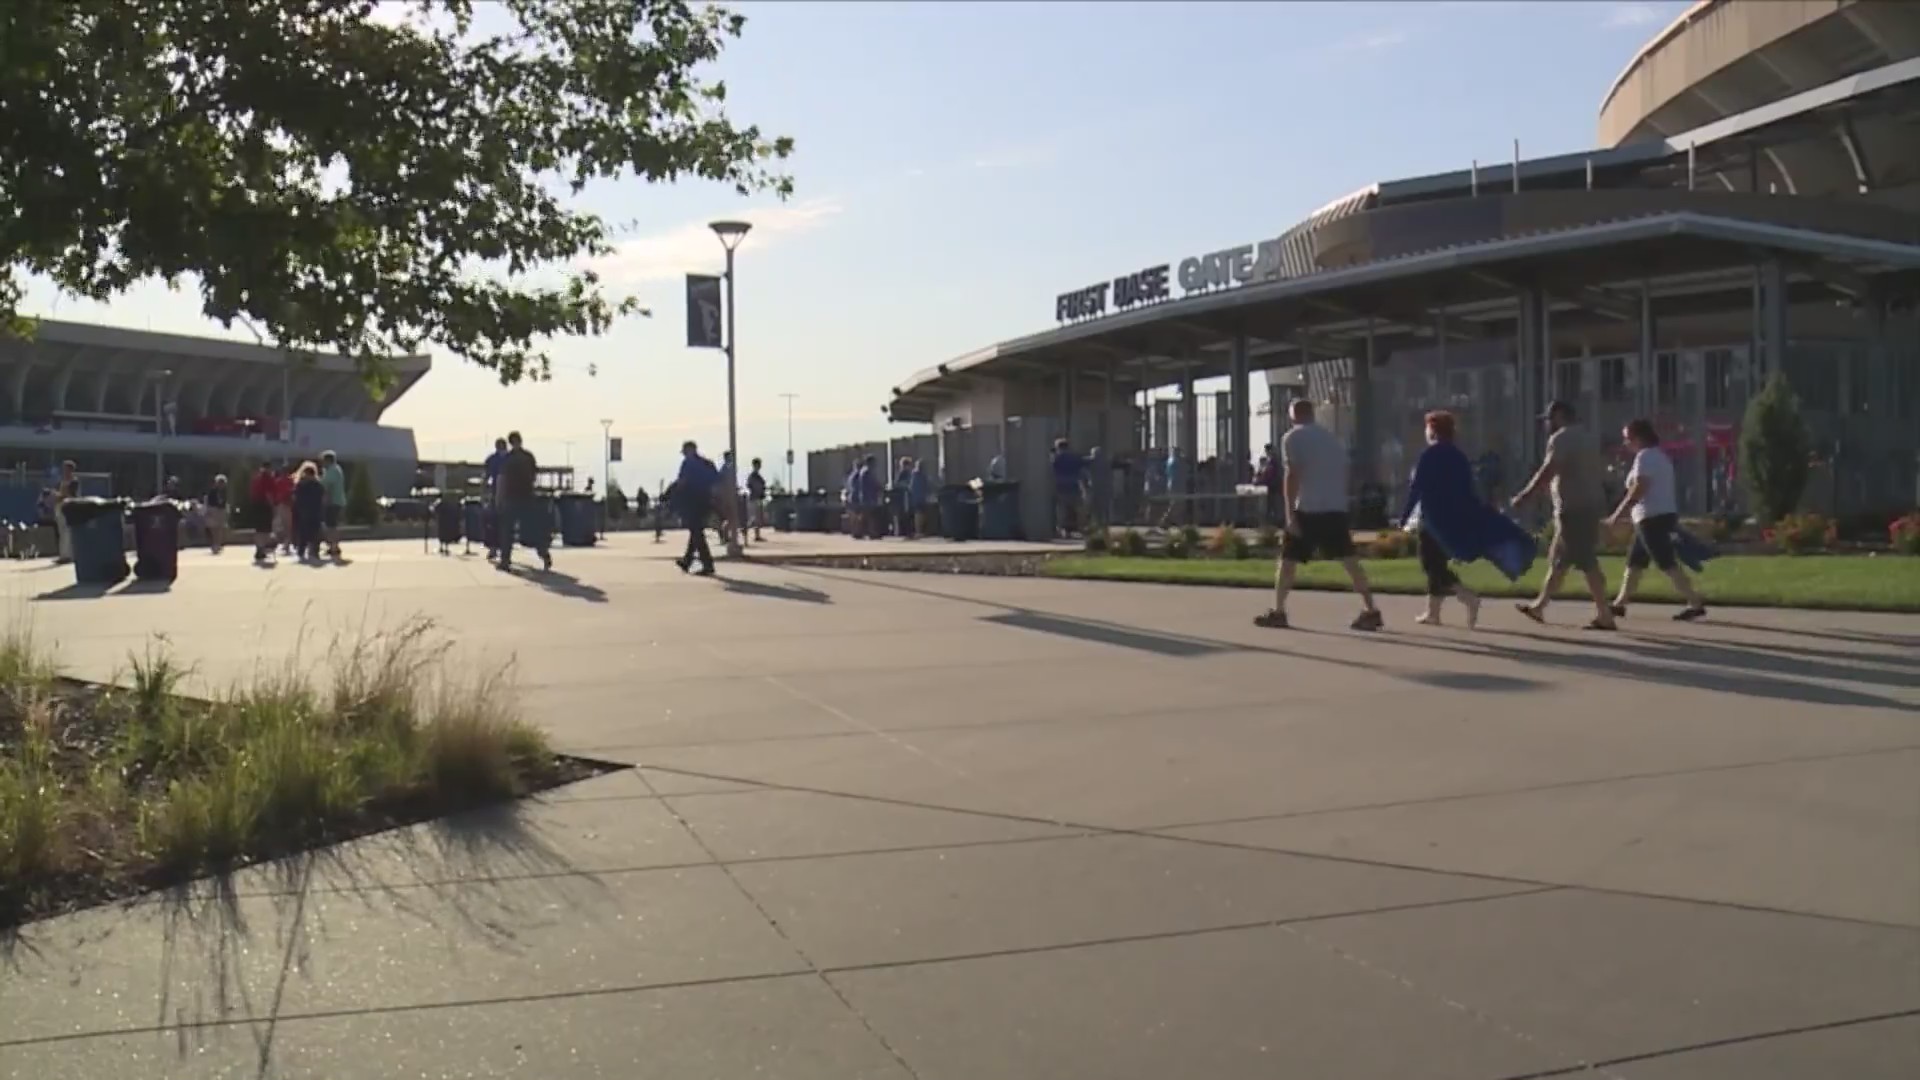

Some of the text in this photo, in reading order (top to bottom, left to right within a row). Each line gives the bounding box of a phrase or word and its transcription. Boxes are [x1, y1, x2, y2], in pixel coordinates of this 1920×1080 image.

[1056, 282, 1110, 321] FIRST
[1114, 264, 1170, 308] BASE
[1178, 244, 1253, 292] GATE
